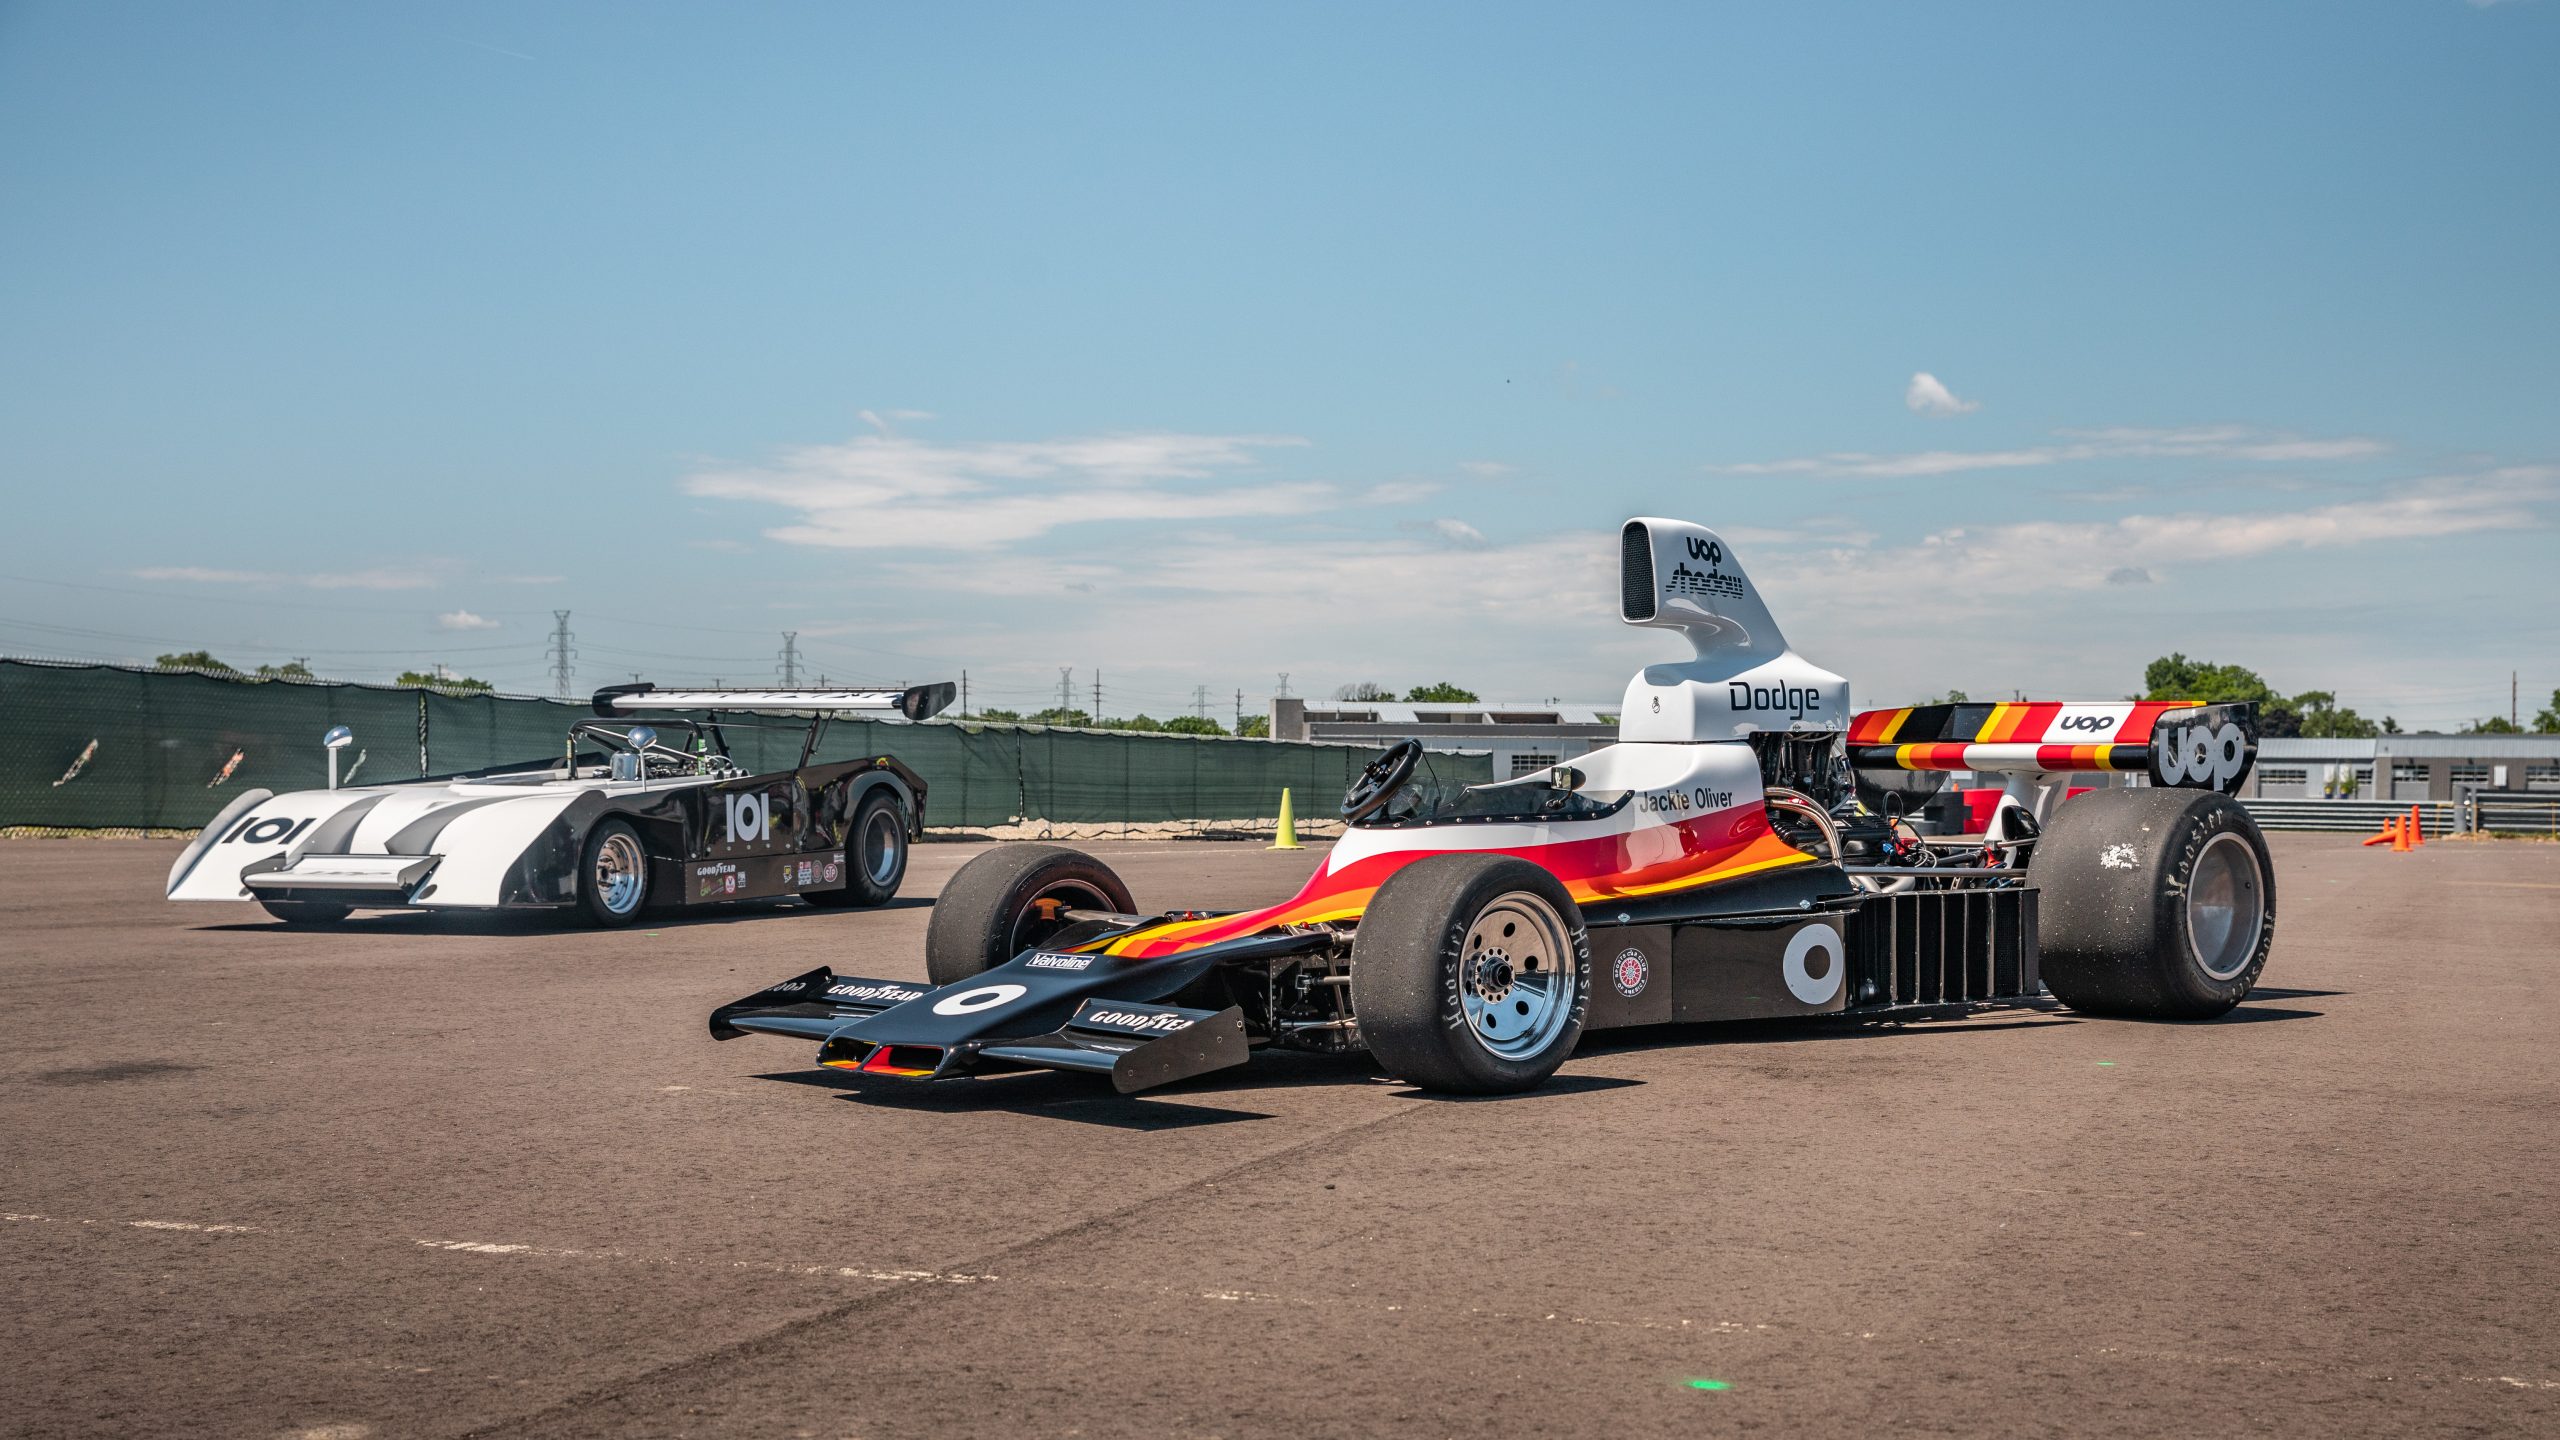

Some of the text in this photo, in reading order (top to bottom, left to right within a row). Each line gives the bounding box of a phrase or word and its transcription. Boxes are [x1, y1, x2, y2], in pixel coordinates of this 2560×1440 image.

[1665, 562, 1744, 599] shadow
[1729, 679, 1820, 720] Dodge
[1640, 787, 1733, 813] Jackie Oliver
[725, 792, 770, 843] 101
[221, 817, 317, 845] 101
[825, 865, 836, 879] STP
[1031, 954, 1092, 969] Valvoline
[1637, 955, 1647, 972] CLUB
[1623, 979, 1646, 995] AMERICA
[1089, 1011, 1195, 1032] GOODYEA
